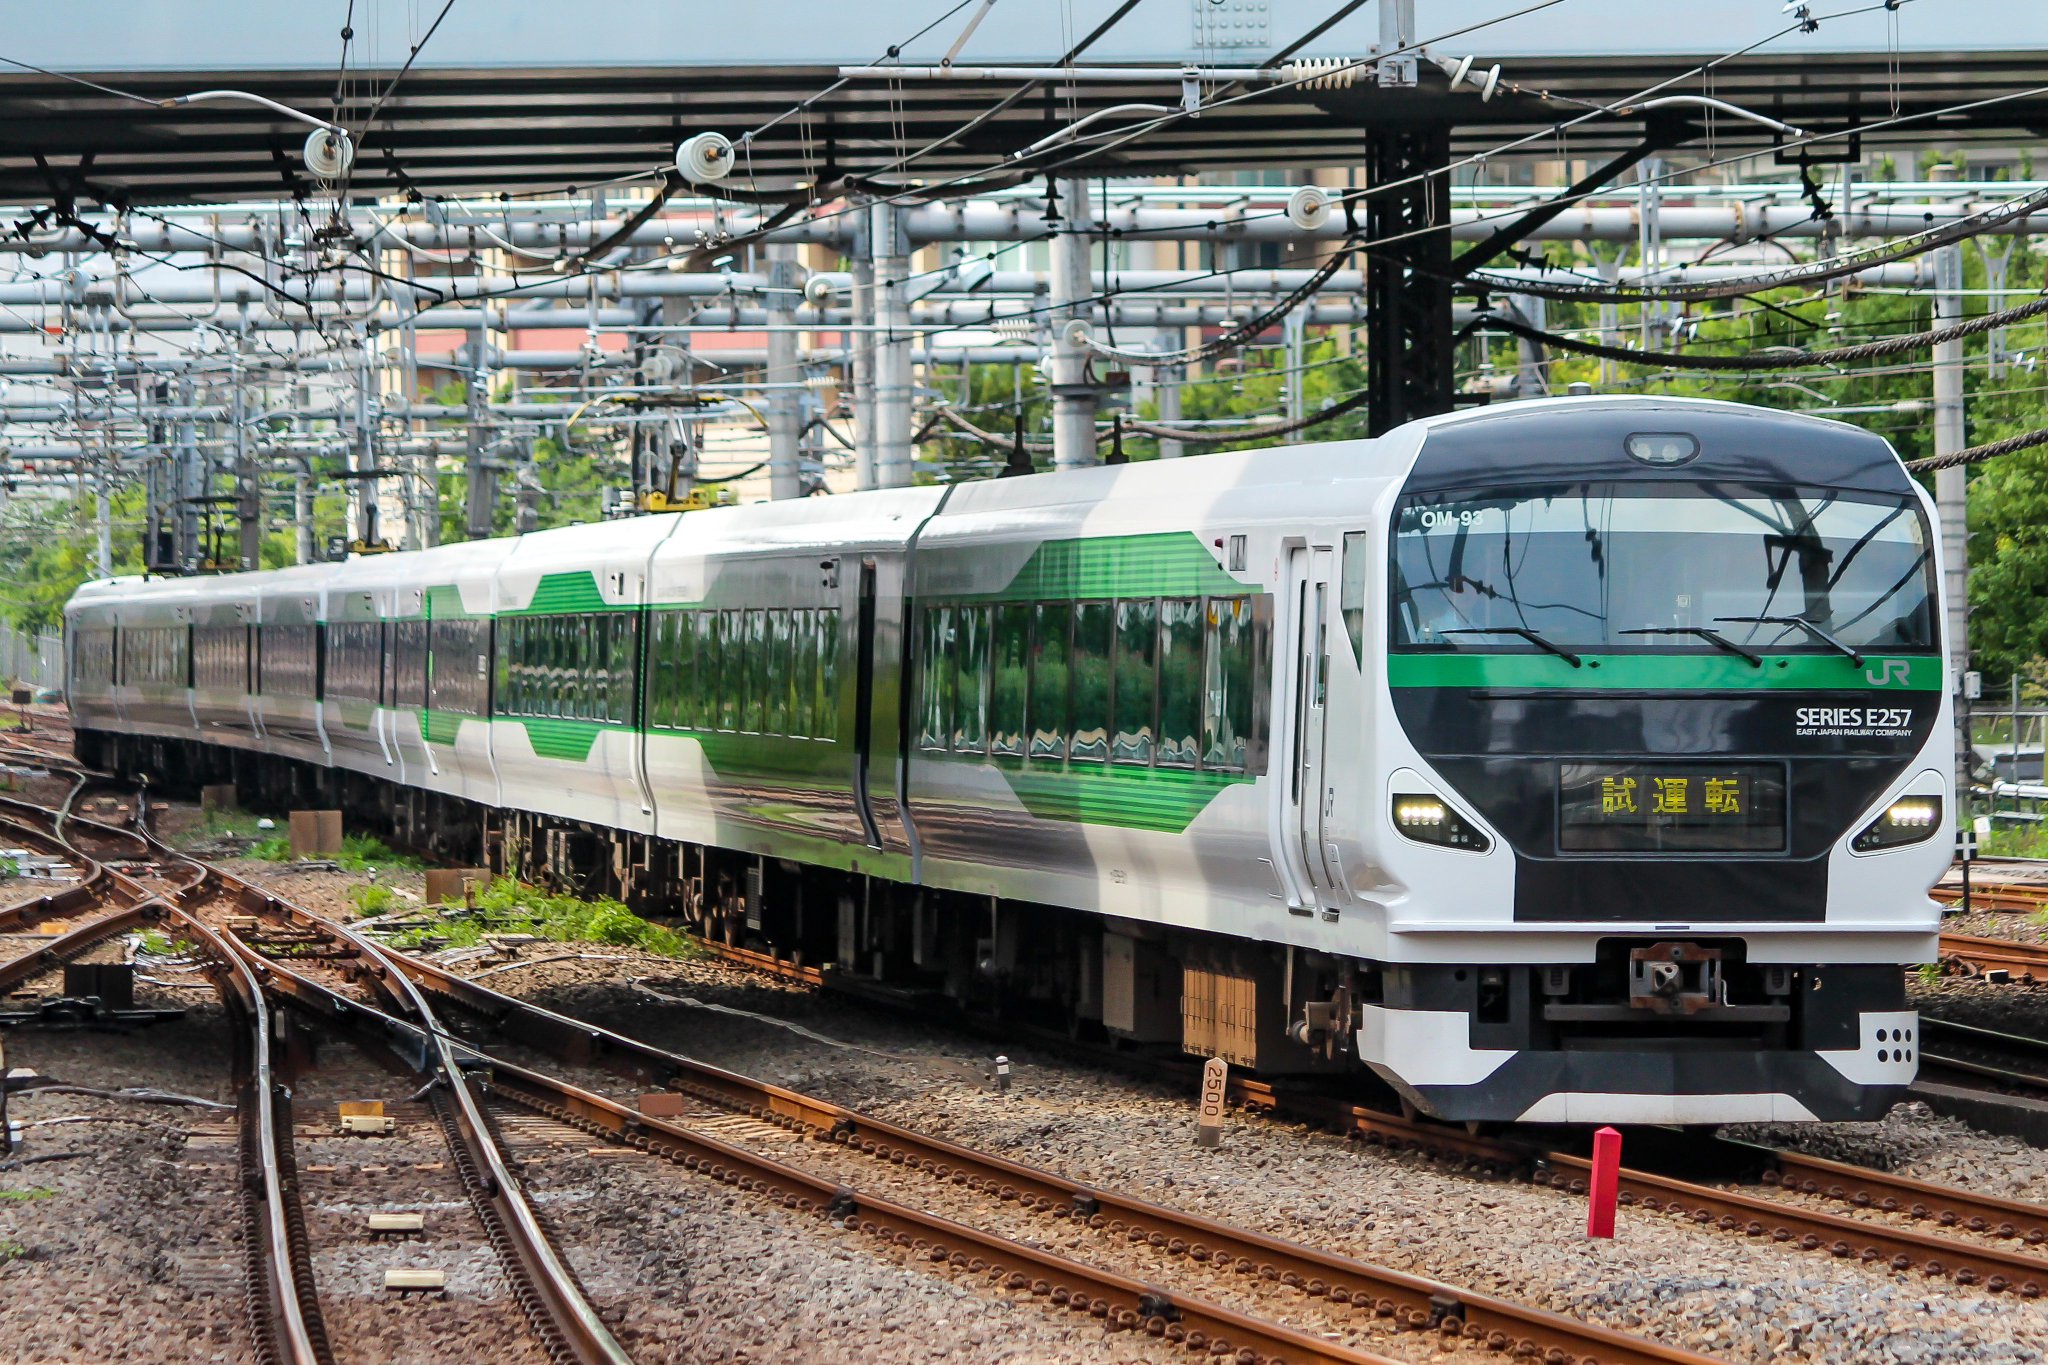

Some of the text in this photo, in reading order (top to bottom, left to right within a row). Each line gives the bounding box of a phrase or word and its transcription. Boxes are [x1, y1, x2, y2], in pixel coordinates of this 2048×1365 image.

[1421, 510, 1484, 528] OM-93
[1866, 660, 1911, 686] JR
[1796, 708, 1912, 727] SERIES E257
[1796, 728, 1912, 737] EAST JAPAN RAILWAY COMPANY
[1602, 777, 1740, 813] 試運転
[1204, 1066, 1222, 1116] 2500
